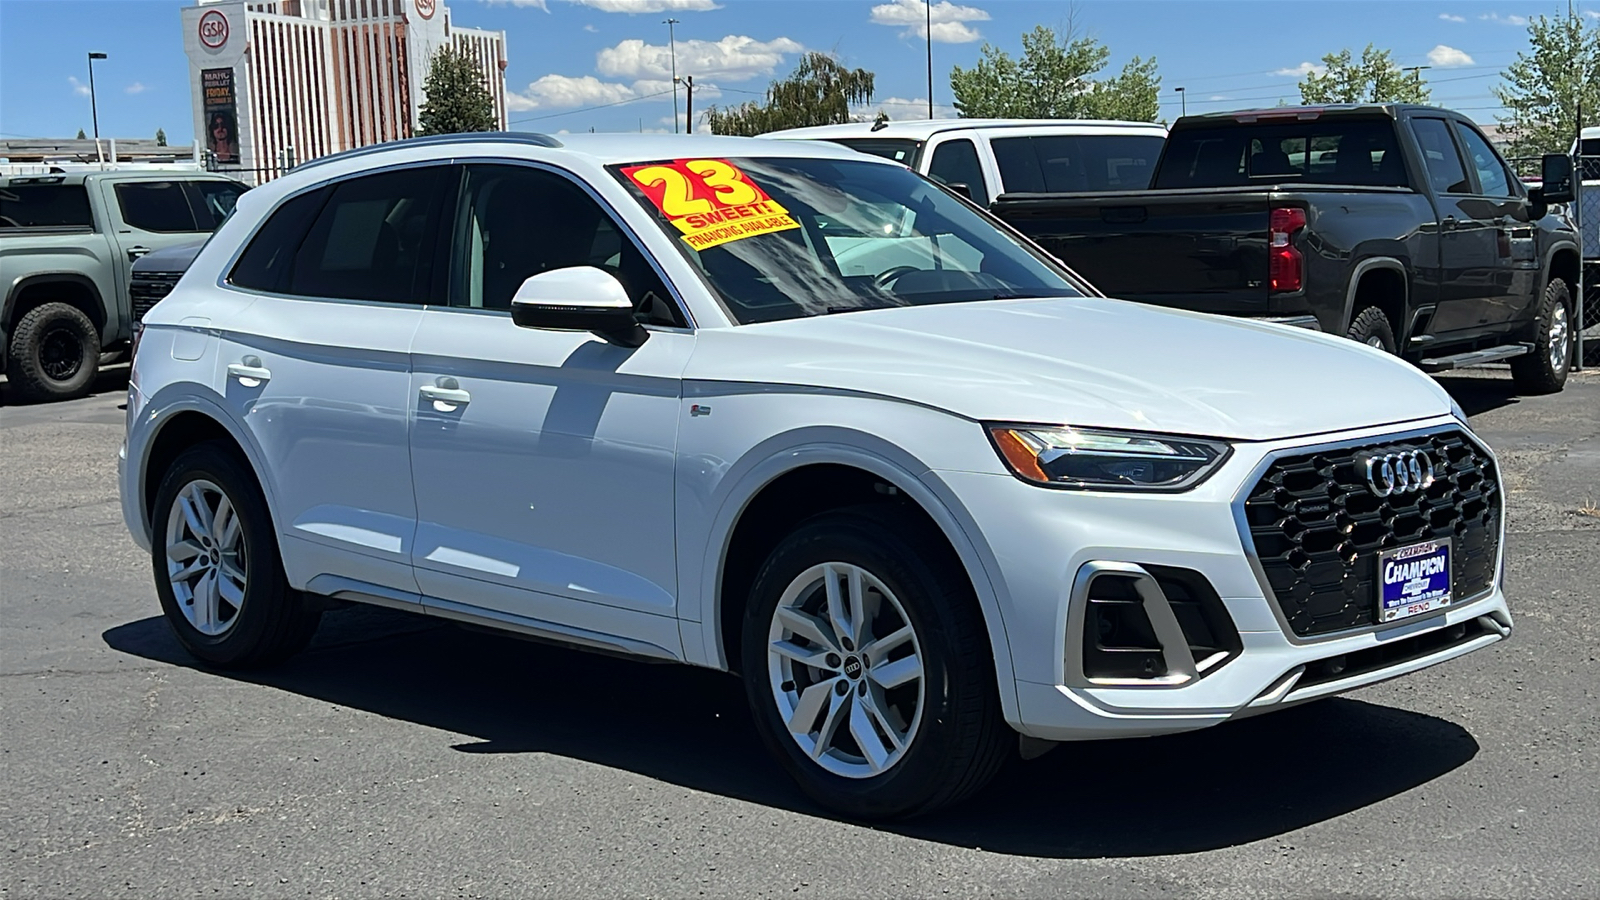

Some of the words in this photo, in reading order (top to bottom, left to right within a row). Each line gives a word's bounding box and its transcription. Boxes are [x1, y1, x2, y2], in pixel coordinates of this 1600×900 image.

[202, 21, 225, 37] GSR
[633, 160, 760, 217] 23
[685, 202, 773, 229] SWEET!
[687, 224, 744, 247] FINANCING
[743, 216, 793, 233] AVAILABLE
[1384, 555, 1446, 585] CHAMPION
[1408, 602, 1430, 614] RENO
